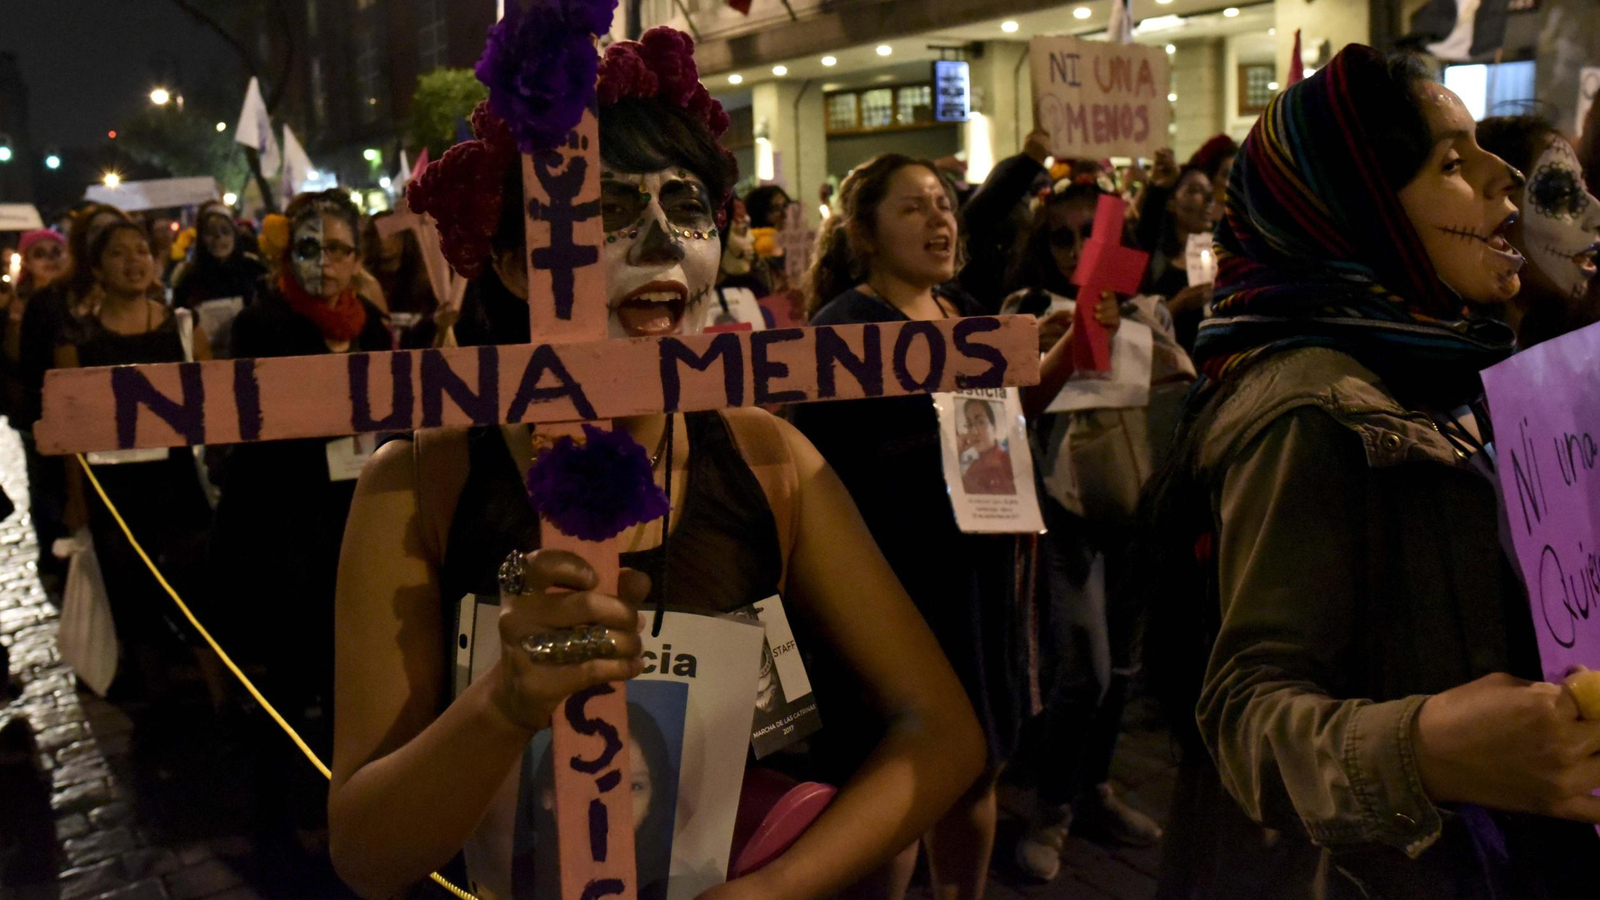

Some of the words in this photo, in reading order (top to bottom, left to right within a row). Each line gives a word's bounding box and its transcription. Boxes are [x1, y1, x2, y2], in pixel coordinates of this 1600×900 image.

[1048, 51, 1082, 87] NI
[1093, 54, 1157, 98] UNA
[1065, 101, 1150, 144] MENOS
[111, 358, 263, 449] NI
[348, 344, 598, 432] UNA
[659, 316, 1008, 413] MENOS
[641, 643, 697, 678] cia
[773, 639, 797, 658] STAFF
[752, 723, 776, 739] MARCHA
[775, 718, 784, 728] DE
[783, 714, 794, 724] LAS
[792, 702, 818, 719] CATRINAS
[782, 724, 795, 735] 2017
